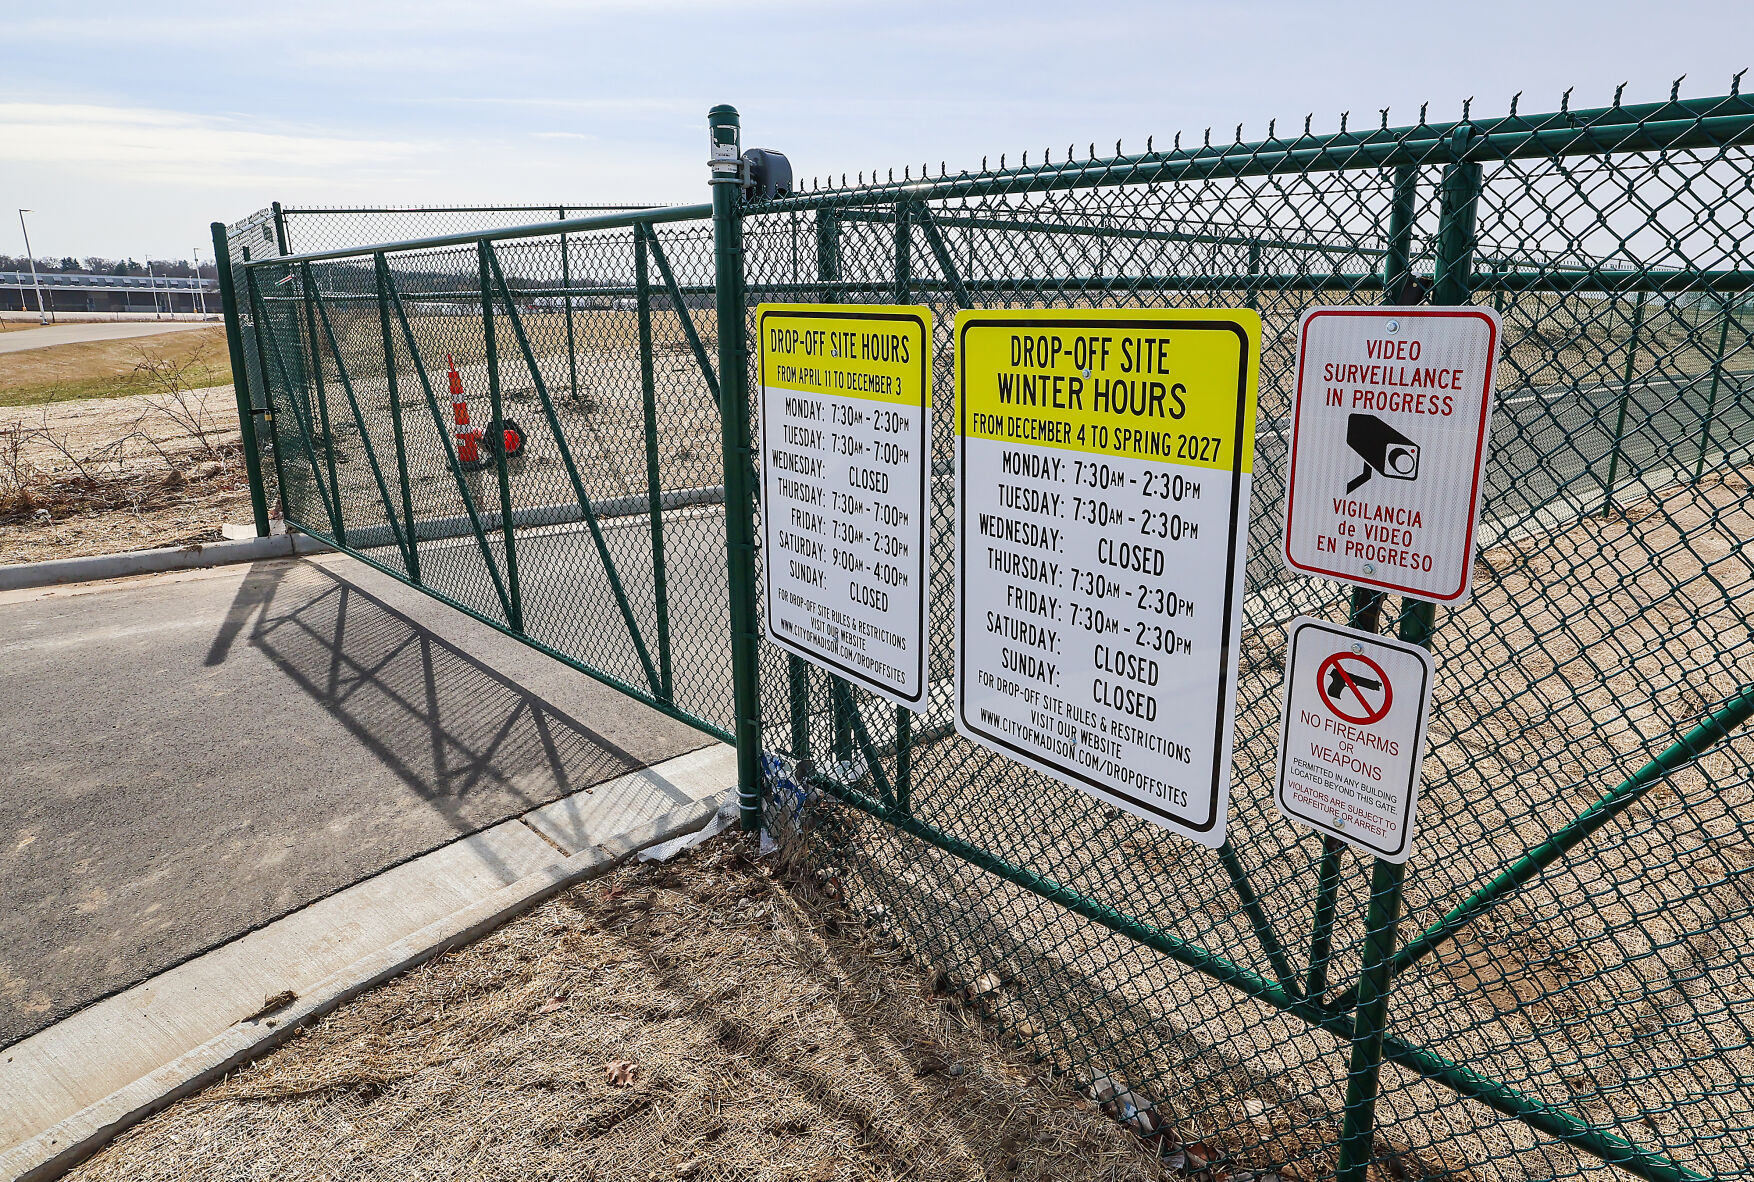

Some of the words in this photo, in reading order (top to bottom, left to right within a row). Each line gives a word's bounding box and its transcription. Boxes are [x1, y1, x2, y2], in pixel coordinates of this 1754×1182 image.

[771, 329, 825, 356] DROP-OFF
[831, 332, 858, 360] SITE
[862, 334, 909, 364] HOURS
[1011, 335, 1112, 371] DROP-OFF
[1121, 337, 1170, 374] SITE
[1367, 340, 1421, 360] VIDEO
[777, 366, 797, 383] FROM
[799, 369, 822, 387] APRIL
[824, 371, 831, 387] 11
[834, 373, 845, 389] TO
[847, 374, 892, 394] DECEMBER
[896, 378, 902, 395] 3
[998, 373, 1083, 410] WINTER
[1094, 378, 1187, 420] HOURS
[1324, 363, 1464, 390] SURVEILLANCE
[785, 398, 825, 422] MONDAY:
[832, 404, 863, 426] 7:30AM
[874, 410, 909, 434] 2:30PM
[1326, 388, 1342, 407] IN
[1353, 390, 1453, 416] PROGRESS
[784, 425, 825, 451] TUESDAY:
[832, 433, 863, 456] 7:30AM
[874, 441, 909, 464] 7:00PM
[974, 413, 1003, 436] FROM
[1008, 417, 1071, 444] DECEMBER
[1077, 424, 1085, 445] 4
[1091, 426, 1108, 448] TO
[1114, 428, 1171, 457] SPRING
[1177, 434, 1222, 462] 2027
[772, 450, 825, 480] WEDNESDAY:
[849, 466, 888, 494] CLOSED
[1003, 451, 1065, 483] MONDAY:
[1074, 461, 1124, 490] 7:30AM
[1143, 471, 1201, 502] 2:30PM
[778, 478, 826, 508] THURSDAY:
[832, 491, 863, 515] 7:30AM
[874, 501, 908, 526] 7:00PM
[998, 484, 1064, 518] TUESDAY:
[1073, 498, 1122, 527] 7:30AM
[1141, 510, 1198, 541] 2:30PM
[1333, 498, 1422, 528] VIGILANCIA
[791, 508, 826, 536] FRIDAY:
[832, 520, 863, 544] 7:30AM
[874, 532, 908, 558] 2:30PM
[979, 513, 1064, 553] WEDNESDAY:
[1098, 538, 1164, 576] CLOSED
[1317, 536, 1336, 553] EN
[1345, 540, 1432, 572] PROGRESO
[1338, 521, 1355, 537] de
[1364, 524, 1412, 547] VIDEO
[779, 530, 826, 563] SATURDAY:
[832, 548, 863, 574] 9:00AM
[874, 562, 908, 587] 4:00PM
[789, 560, 827, 590] SUNDAY:
[850, 582, 888, 612] CLOSED
[988, 547, 1063, 588] THURSDAY:
[1072, 569, 1120, 599] 7:30AM
[1138, 585, 1194, 618] 2:30PM
[778, 588, 788, 602] FOR
[789, 592, 815, 614] DROP-OFF
[818, 605, 829, 620] SITE
[831, 610, 850, 627] RULES
[852, 621, 857, 631] &
[859, 622, 906, 650] RESTRICTIONS
[810, 617, 825, 634] VISIT
[827, 627, 839, 640] OUR
[840, 631, 866, 650] WEBSITE
[1007, 585, 1061, 622] FRIDAY:
[1070, 603, 1118, 634] 7:30AM
[1136, 622, 1192, 655] 2:30PM
[780, 618, 906, 684] WWW.CITYOFMADISON.COM/DROPOFFSITES
[987, 612, 1061, 655] SATURDAY:
[1095, 644, 1159, 686] CLOSED
[1002, 649, 1060, 687] SUNDAY:
[1093, 679, 1157, 722] CLOSED
[978, 670, 994, 689] FOR
[996, 676, 1040, 706] DROP-OFF
[1044, 696, 1063, 715] SITE
[1066, 705, 1096, 728] RULES
[1100, 718, 1106, 731] &
[1111, 721, 1191, 764] RESTRICTIONS
[1031, 710, 1053, 732] VISIT
[1058, 721, 1077, 738] OUR
[1080, 729, 1122, 760] WEBSITE
[1300, 710, 1320, 728] NO
[1325, 719, 1399, 756] FIREARMS
[980, 707, 1188, 808] WWW.CITYOFMADISON.COM/DROPOFFSITES
[1310, 743, 1382, 781] WEAPONS
[1339, 740, 1354, 754] OR
[1291, 766, 1323, 786] LOCATED
[1324, 779, 1354, 798] BEYOND
[1357, 791, 1373, 805] THIS
[1375, 799, 1398, 815] GATE.
[1293, 758, 1333, 779] PERMITTED
[1335, 771, 1342, 782] IN
[1344, 774, 1359, 788] ANY
[1361, 782, 1397, 804] BUILDING
[1288, 780, 1329, 803] VIOLATORS
[1330, 796, 1346, 809] ARE
[1348, 803, 1383, 825] SUBJECT
[1383, 819, 1396, 831] TO
[1293, 792, 1340, 818] FORFEITURE
[1342, 812, 1353, 822] OR
[1354, 817, 1387, 838] ARREST.
